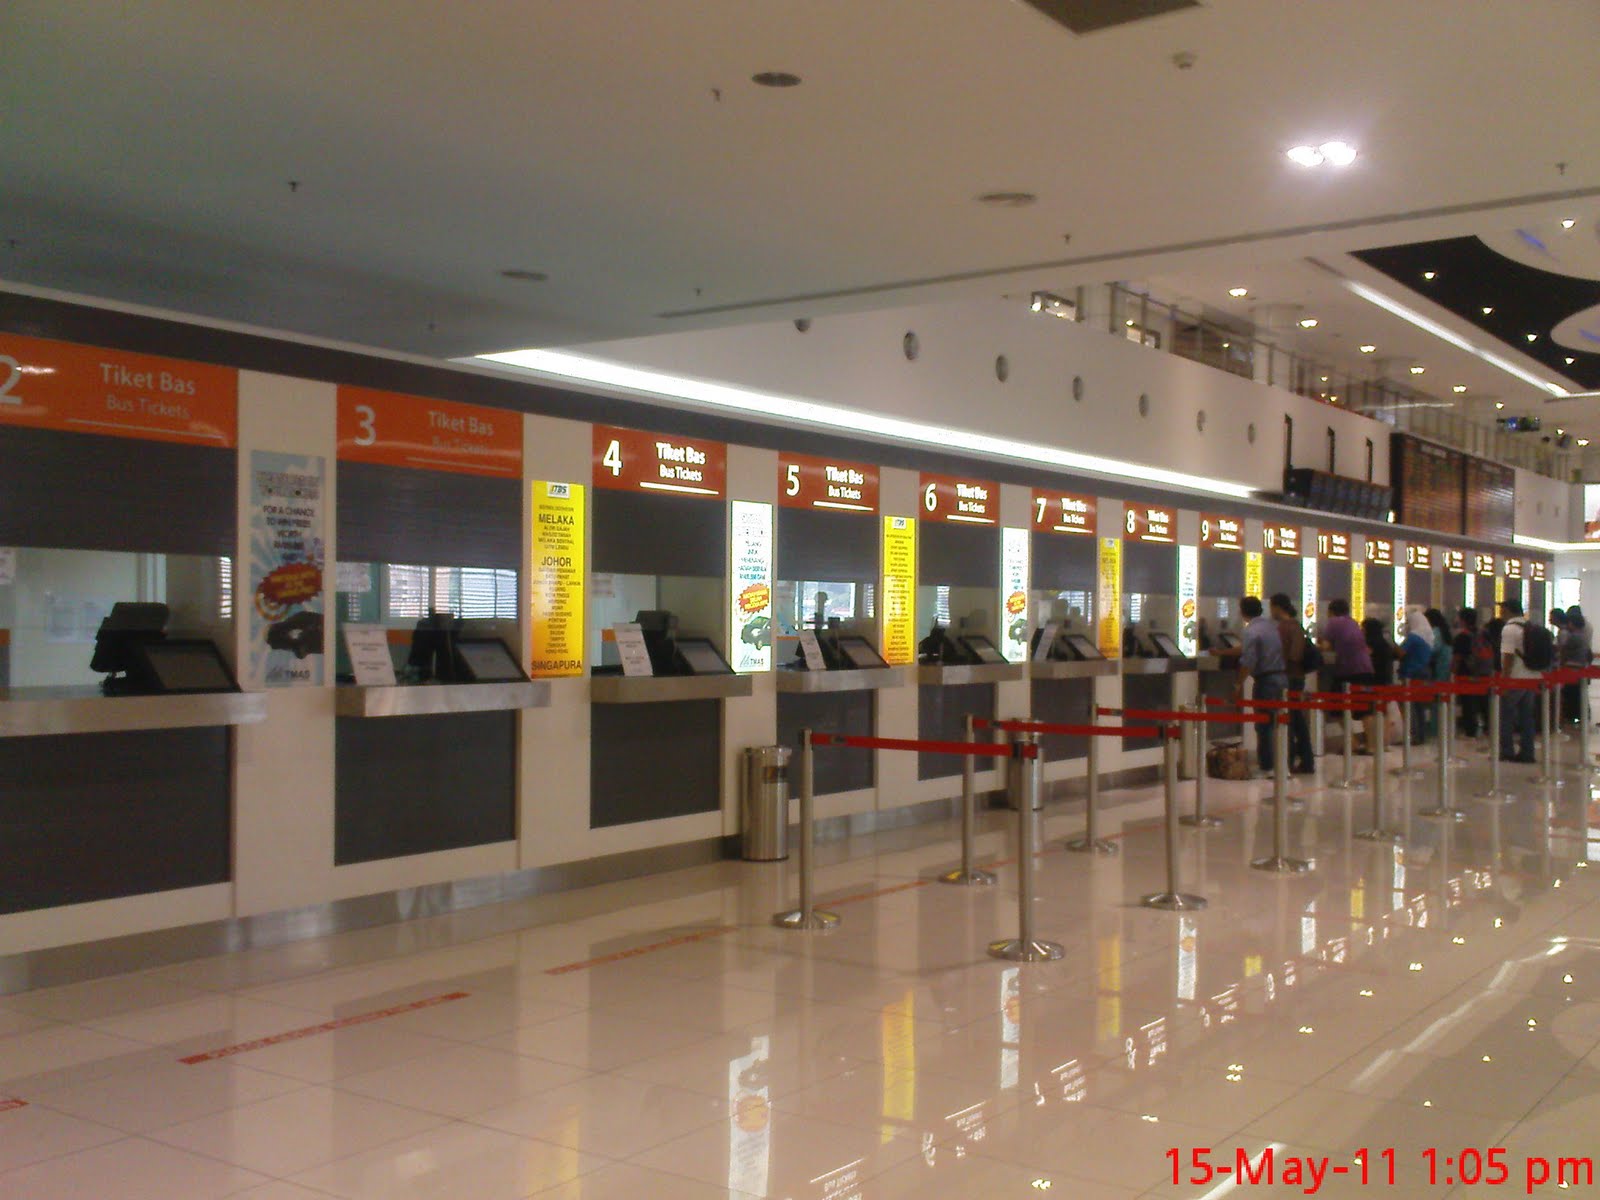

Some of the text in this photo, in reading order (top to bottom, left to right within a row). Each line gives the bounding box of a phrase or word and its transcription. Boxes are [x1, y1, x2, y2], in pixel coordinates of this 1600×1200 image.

[0, 354, 23, 405] 2
[100, 363, 196, 396] Tiket Bas
[107, 395, 190, 419] Bus Tickets
[354, 405, 376, 446] 3
[428, 411, 494, 437] Tiket Bas
[603, 440, 622, 476] 4
[656, 442, 705, 465] Tiket Bas
[659, 464, 703, 482] Bus Tickets
[786, 464, 800, 496] 5
[849, 469, 864, 485] Bas
[925, 483, 937, 511] 6
[538, 513, 575, 526] MELAKA
[1037, 497, 1047, 523] 7
[1127, 509, 1136, 534] 8
[1202, 520, 1209, 541] 9
[1263, 528, 1275, 549] 10
[1318, 535, 1328, 555] 11
[541, 556, 571, 567] JOHOR
[531, 660, 581, 671] SINGAPURA
